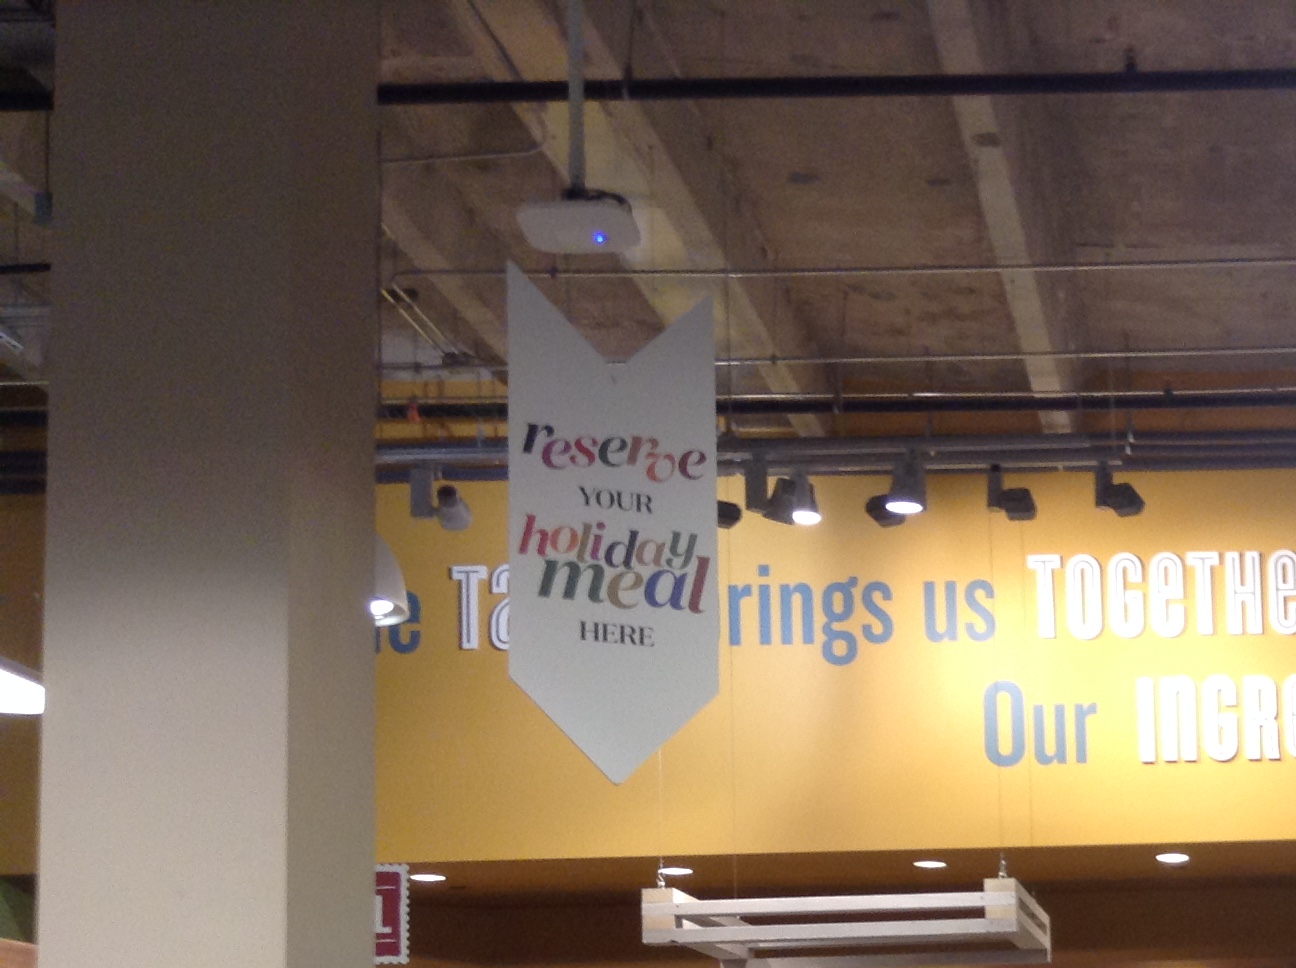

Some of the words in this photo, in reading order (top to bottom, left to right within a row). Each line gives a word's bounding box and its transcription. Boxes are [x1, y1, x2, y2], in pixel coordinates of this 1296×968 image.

[522, 422, 707, 484] reserve
[578, 485, 654, 515] YOUR
[518, 512, 698, 571] holiday
[537, 555, 711, 615] meal
[579, 620, 656, 648] HERE
[718, 564, 894, 668] rings
[923, 576, 997, 643] us
[983, 680, 1098, 767] Our
